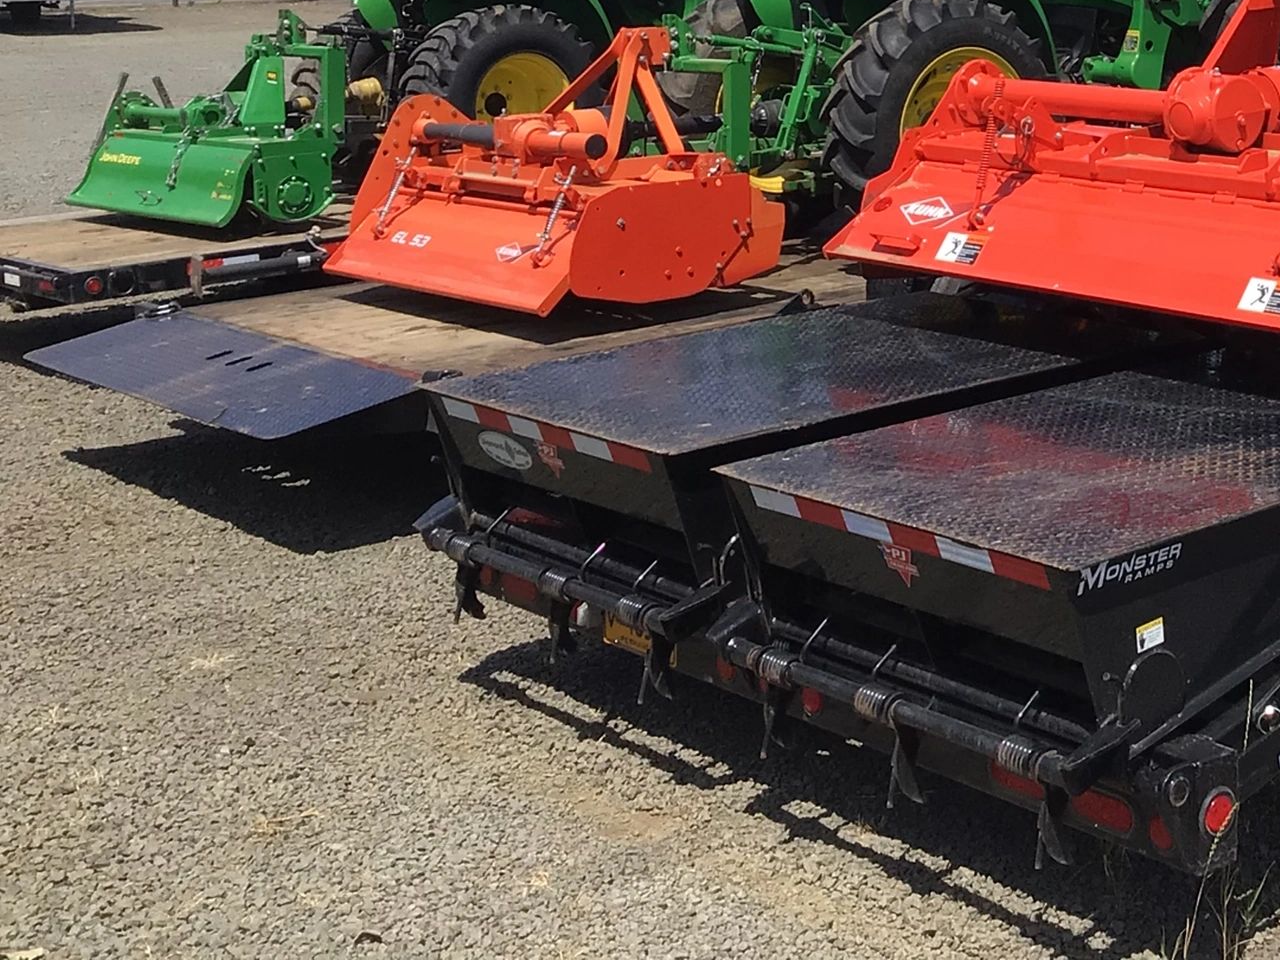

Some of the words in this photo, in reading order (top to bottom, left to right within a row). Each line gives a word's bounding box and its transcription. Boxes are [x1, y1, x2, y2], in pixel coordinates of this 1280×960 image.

[905, 203, 948, 218] KUHN
[391, 231, 408, 244] EL
[408, 234, 432, 248] 53
[891, 548, 905, 561] PJ
[1077, 543, 1182, 596] MONSTER
[1124, 560, 1174, 584] RAMPS
